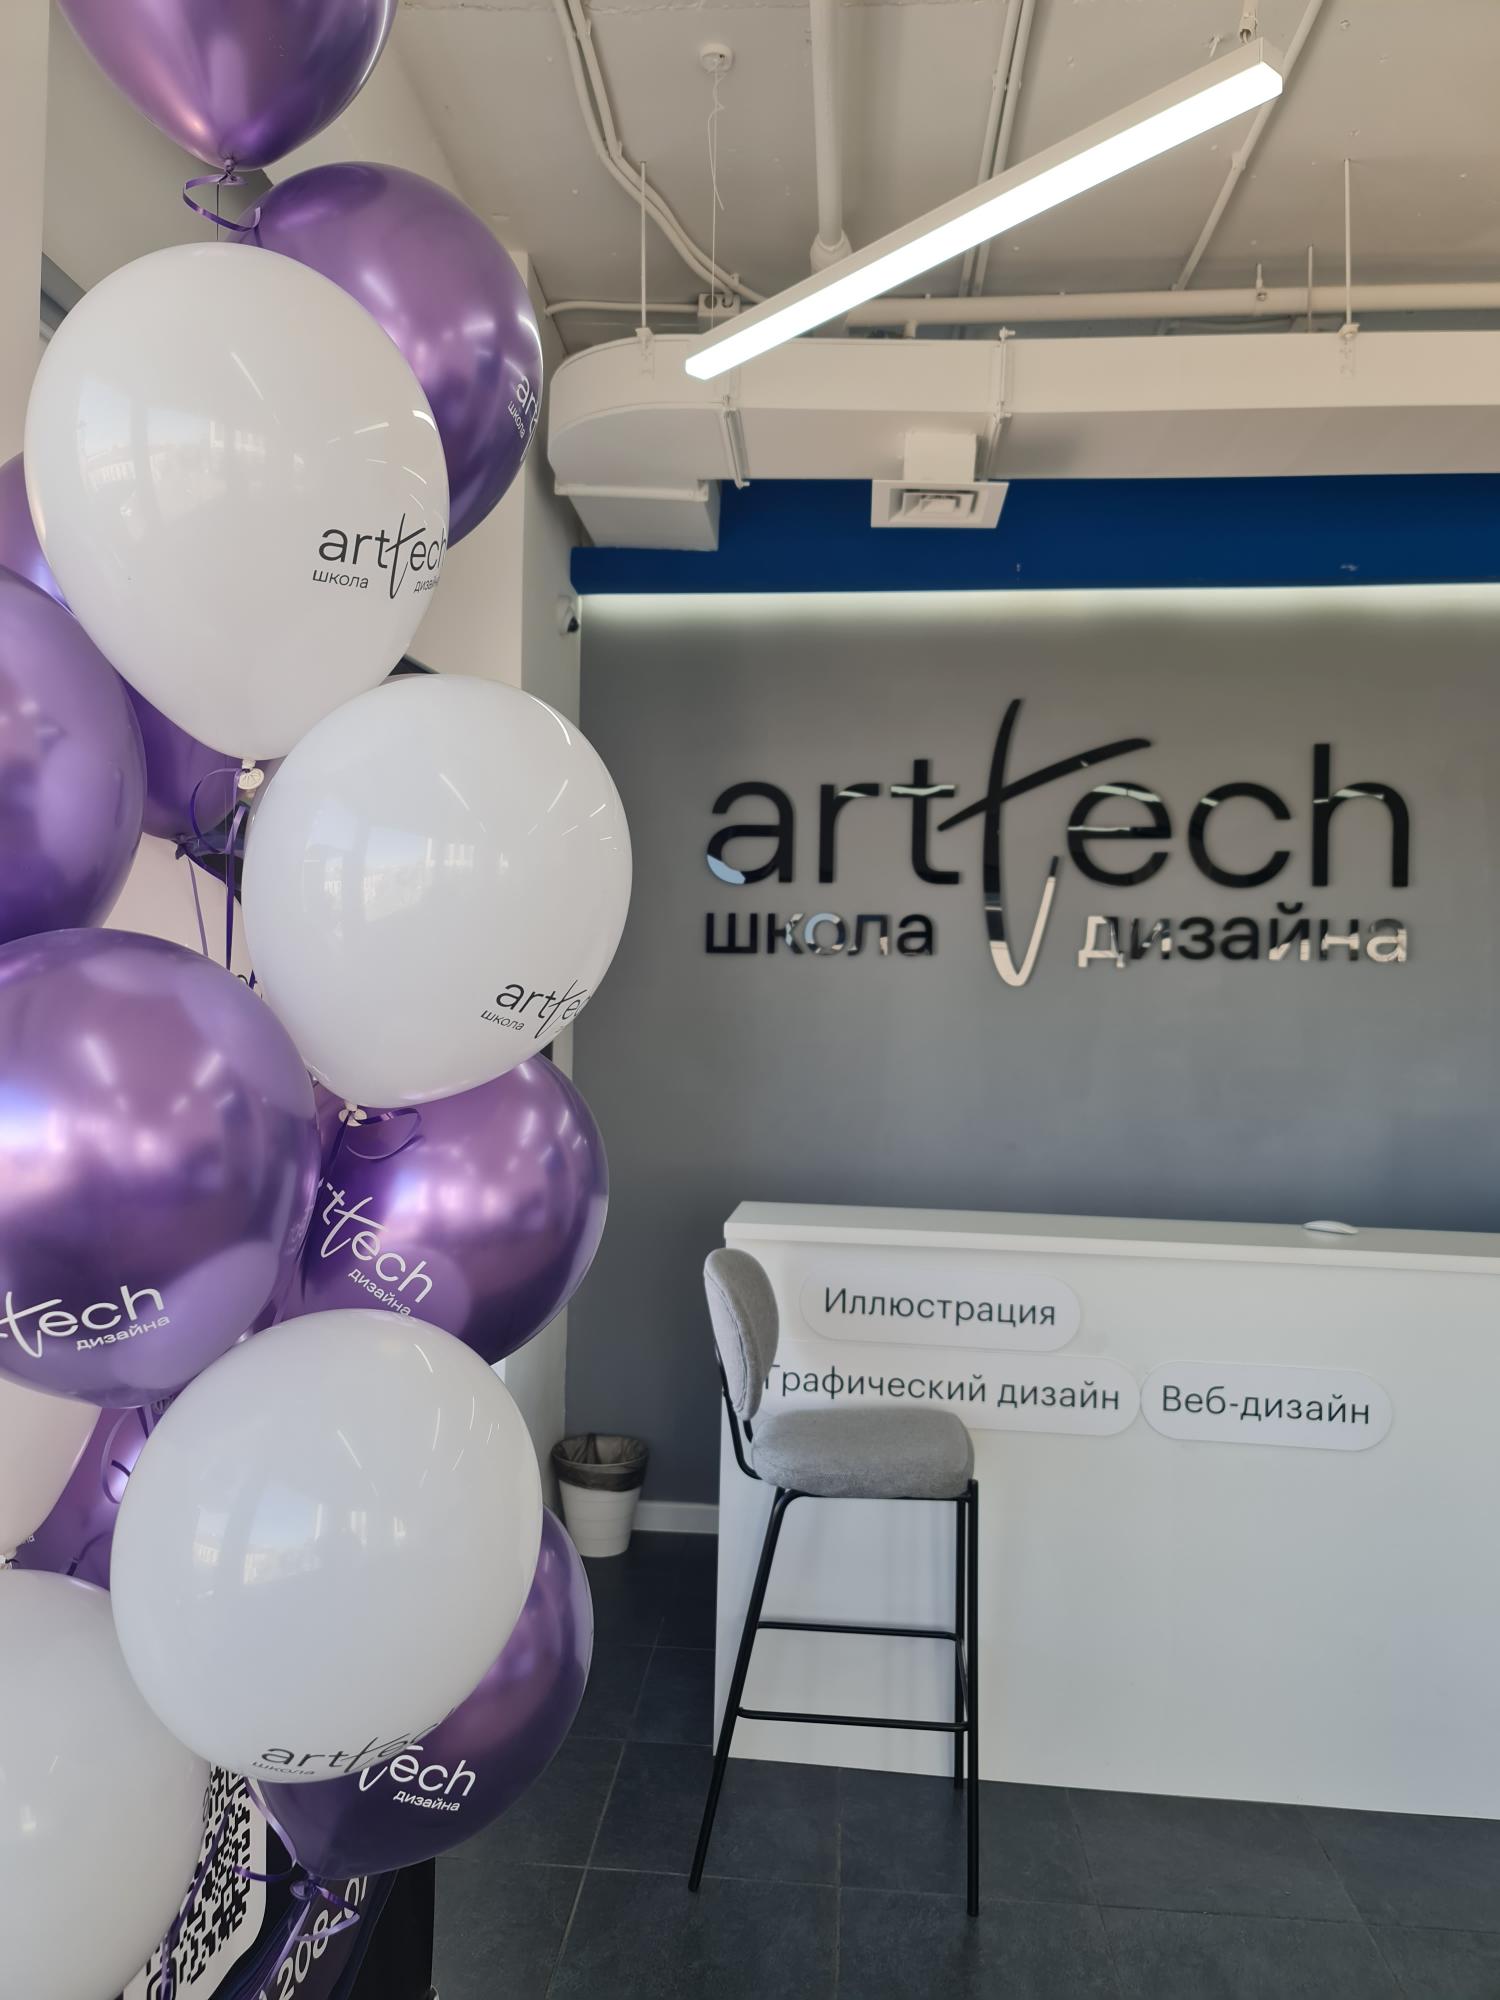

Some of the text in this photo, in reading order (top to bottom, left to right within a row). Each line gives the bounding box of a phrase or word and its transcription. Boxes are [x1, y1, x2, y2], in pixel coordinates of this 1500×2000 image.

[508, 400, 526, 439] школа
[312, 569, 370, 589] школа
[705, 698, 1410, 989] arttech
[704, 902, 1409, 970] школа дизайна
[480, 1009, 526, 1031] школа
[348, 1268, 412, 1316] дизайна
[825, 1287, 1056, 1328] Иллюстрация
[76, 1315, 171, 1351] дизайна
[997, 1379, 1120, 1411] дизайн
[1162, 1384, 1371, 1426] Веб-дизайн
[251, 1761, 316, 1776] школа
[392, 1790, 461, 1812] дизайна
